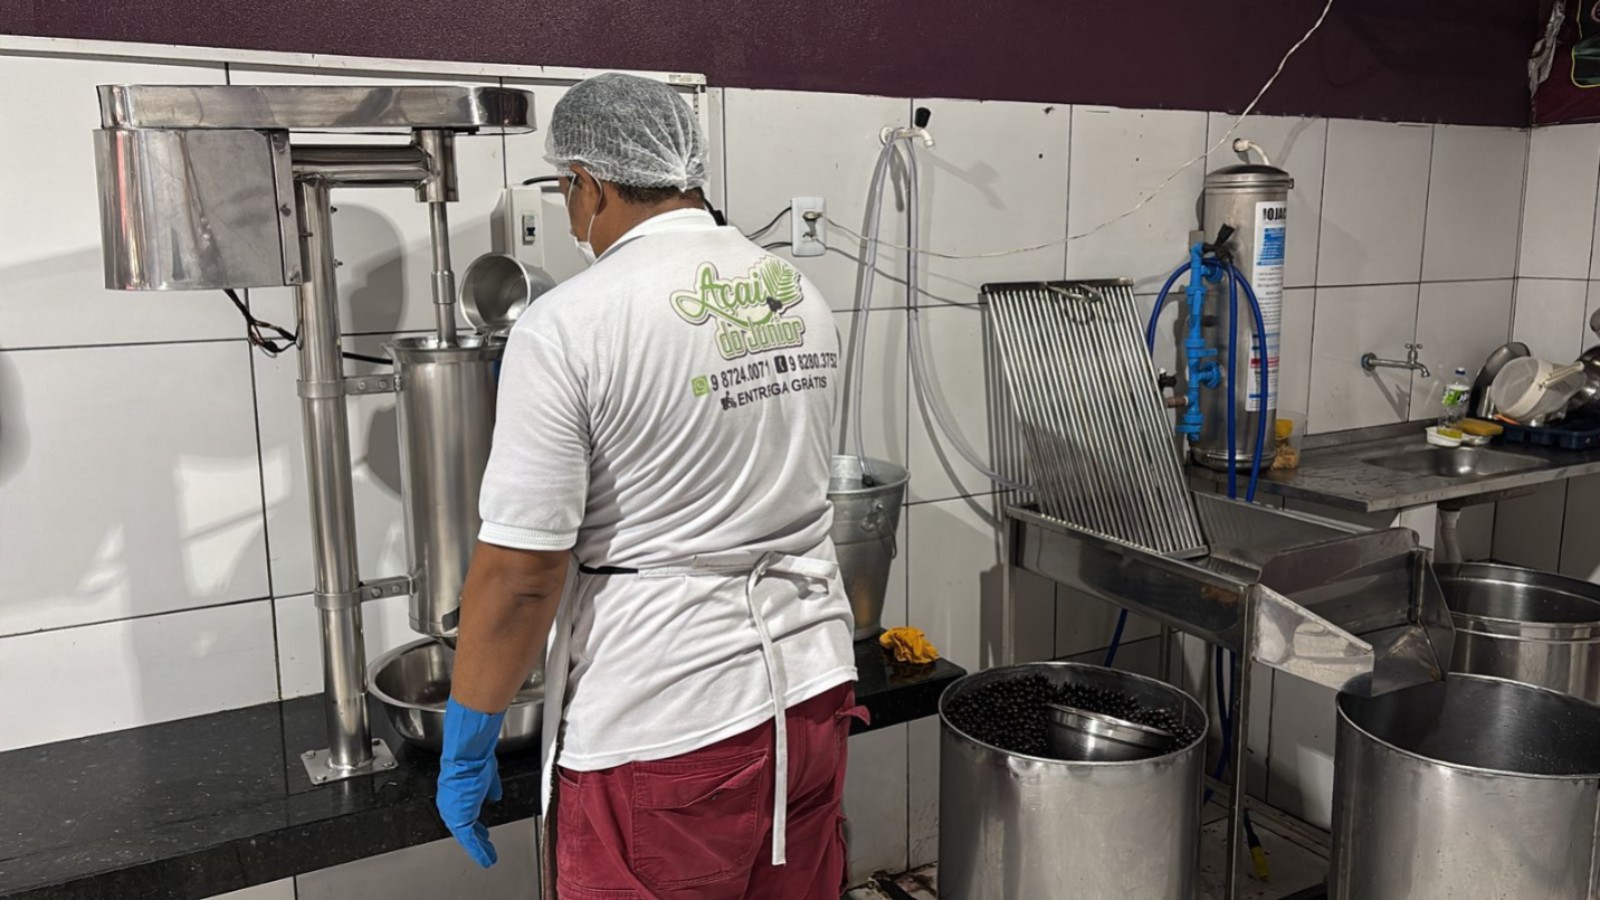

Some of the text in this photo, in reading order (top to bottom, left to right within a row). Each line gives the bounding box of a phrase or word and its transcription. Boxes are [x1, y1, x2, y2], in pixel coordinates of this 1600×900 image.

[719, 320, 744, 354] do
[710, 374, 719, 392] 9
[721, 361, 770, 388] 8724.0071
[788, 355, 797, 372] 9
[791, 374, 827, 392] GRÁTIS
